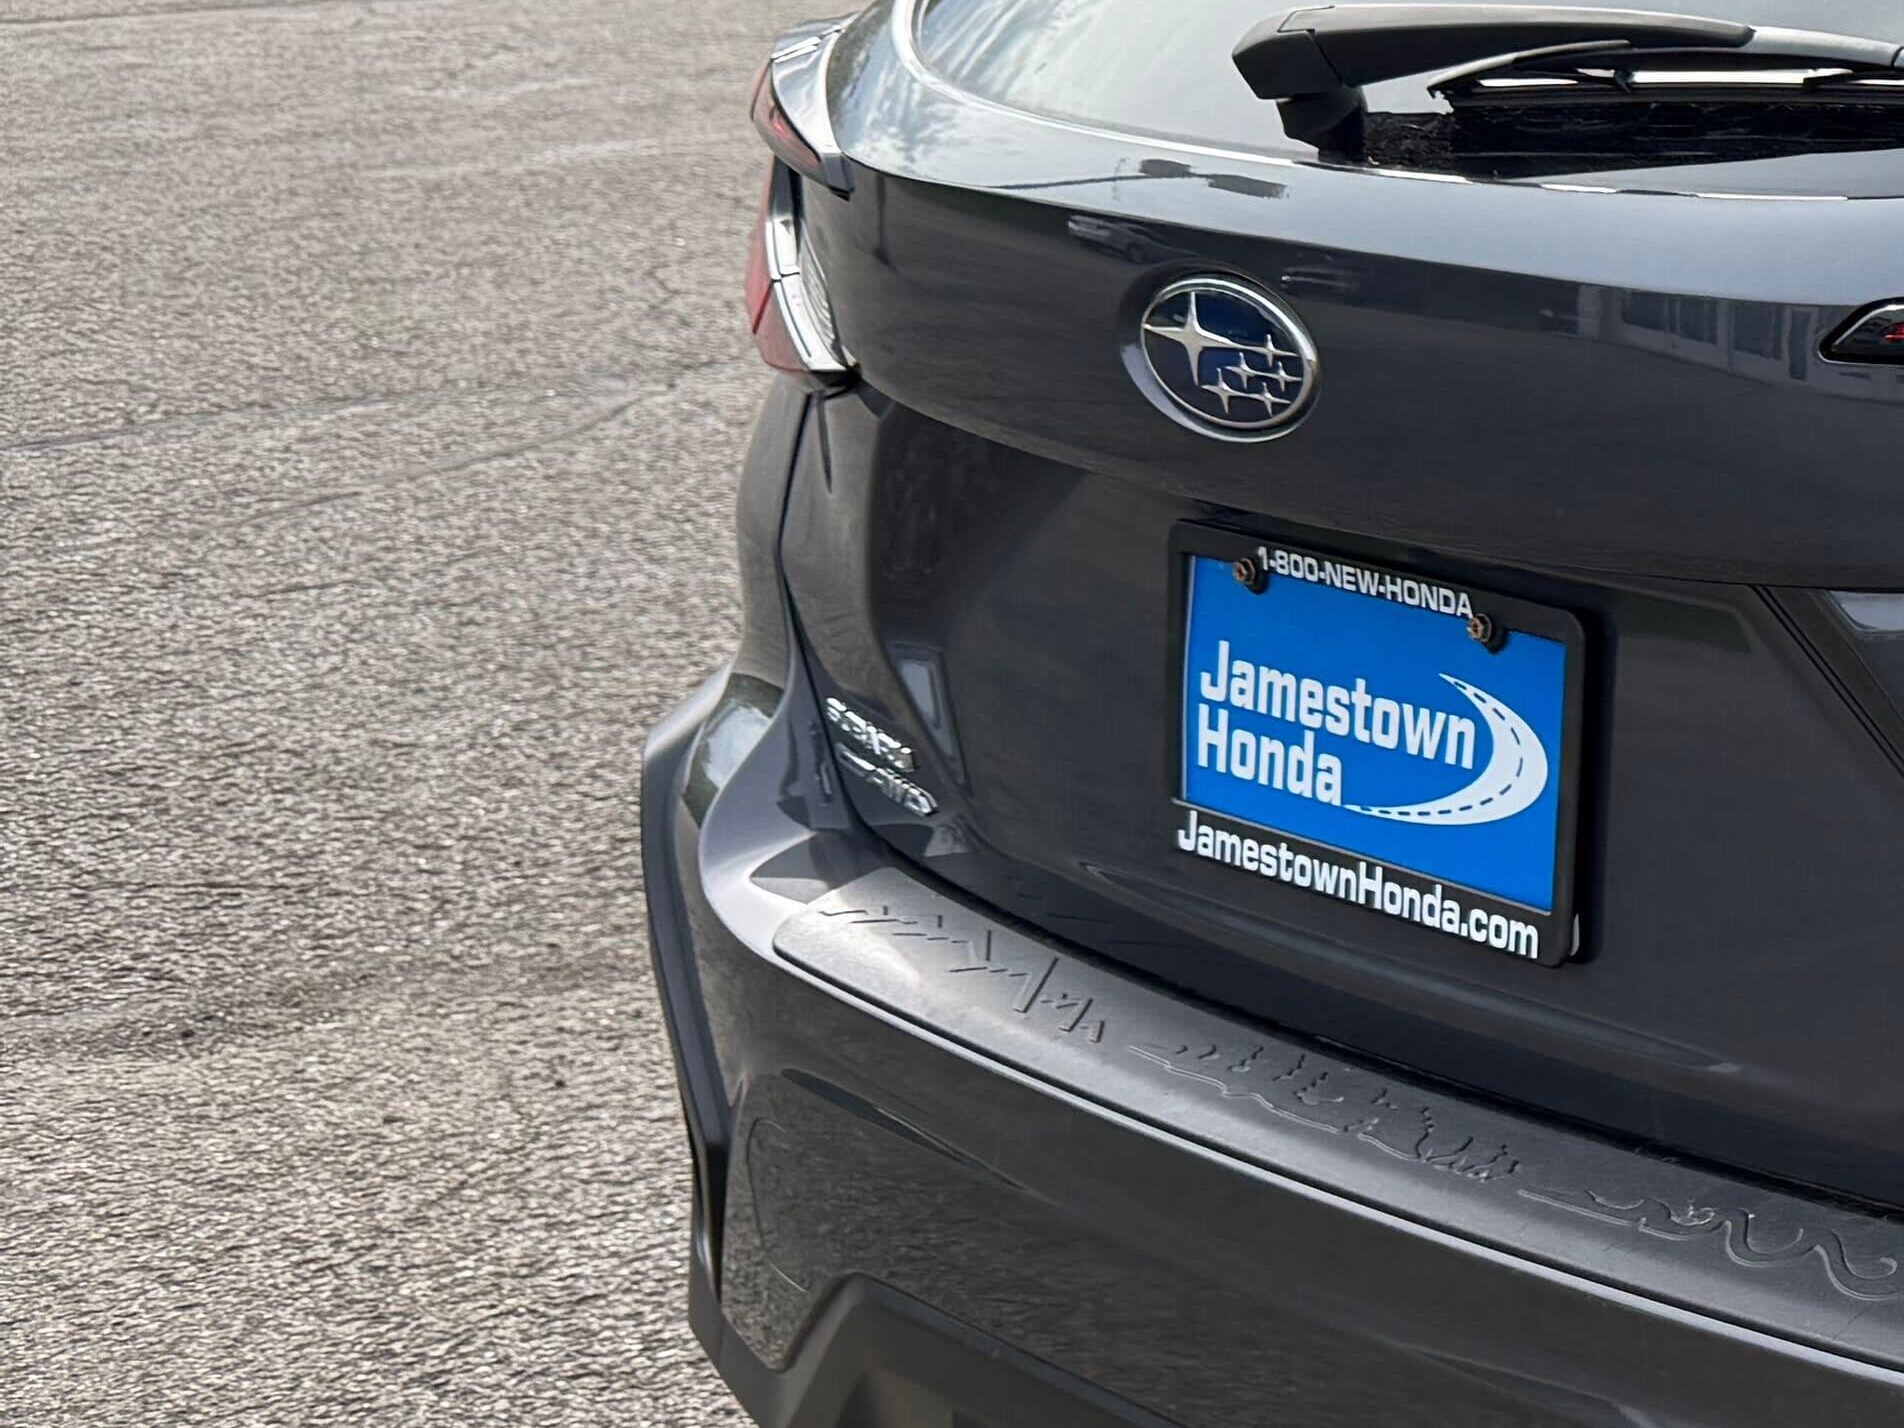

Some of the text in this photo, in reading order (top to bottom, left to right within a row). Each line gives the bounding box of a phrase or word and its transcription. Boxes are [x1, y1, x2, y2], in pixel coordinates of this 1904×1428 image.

[1257, 546, 1474, 618] 1-800-NEW-HONDA
[1197, 703, 1343, 806] Honda
[1201, 640, 1477, 770] Jamestown
[1177, 810, 1539, 960] JamestownHonda.com
